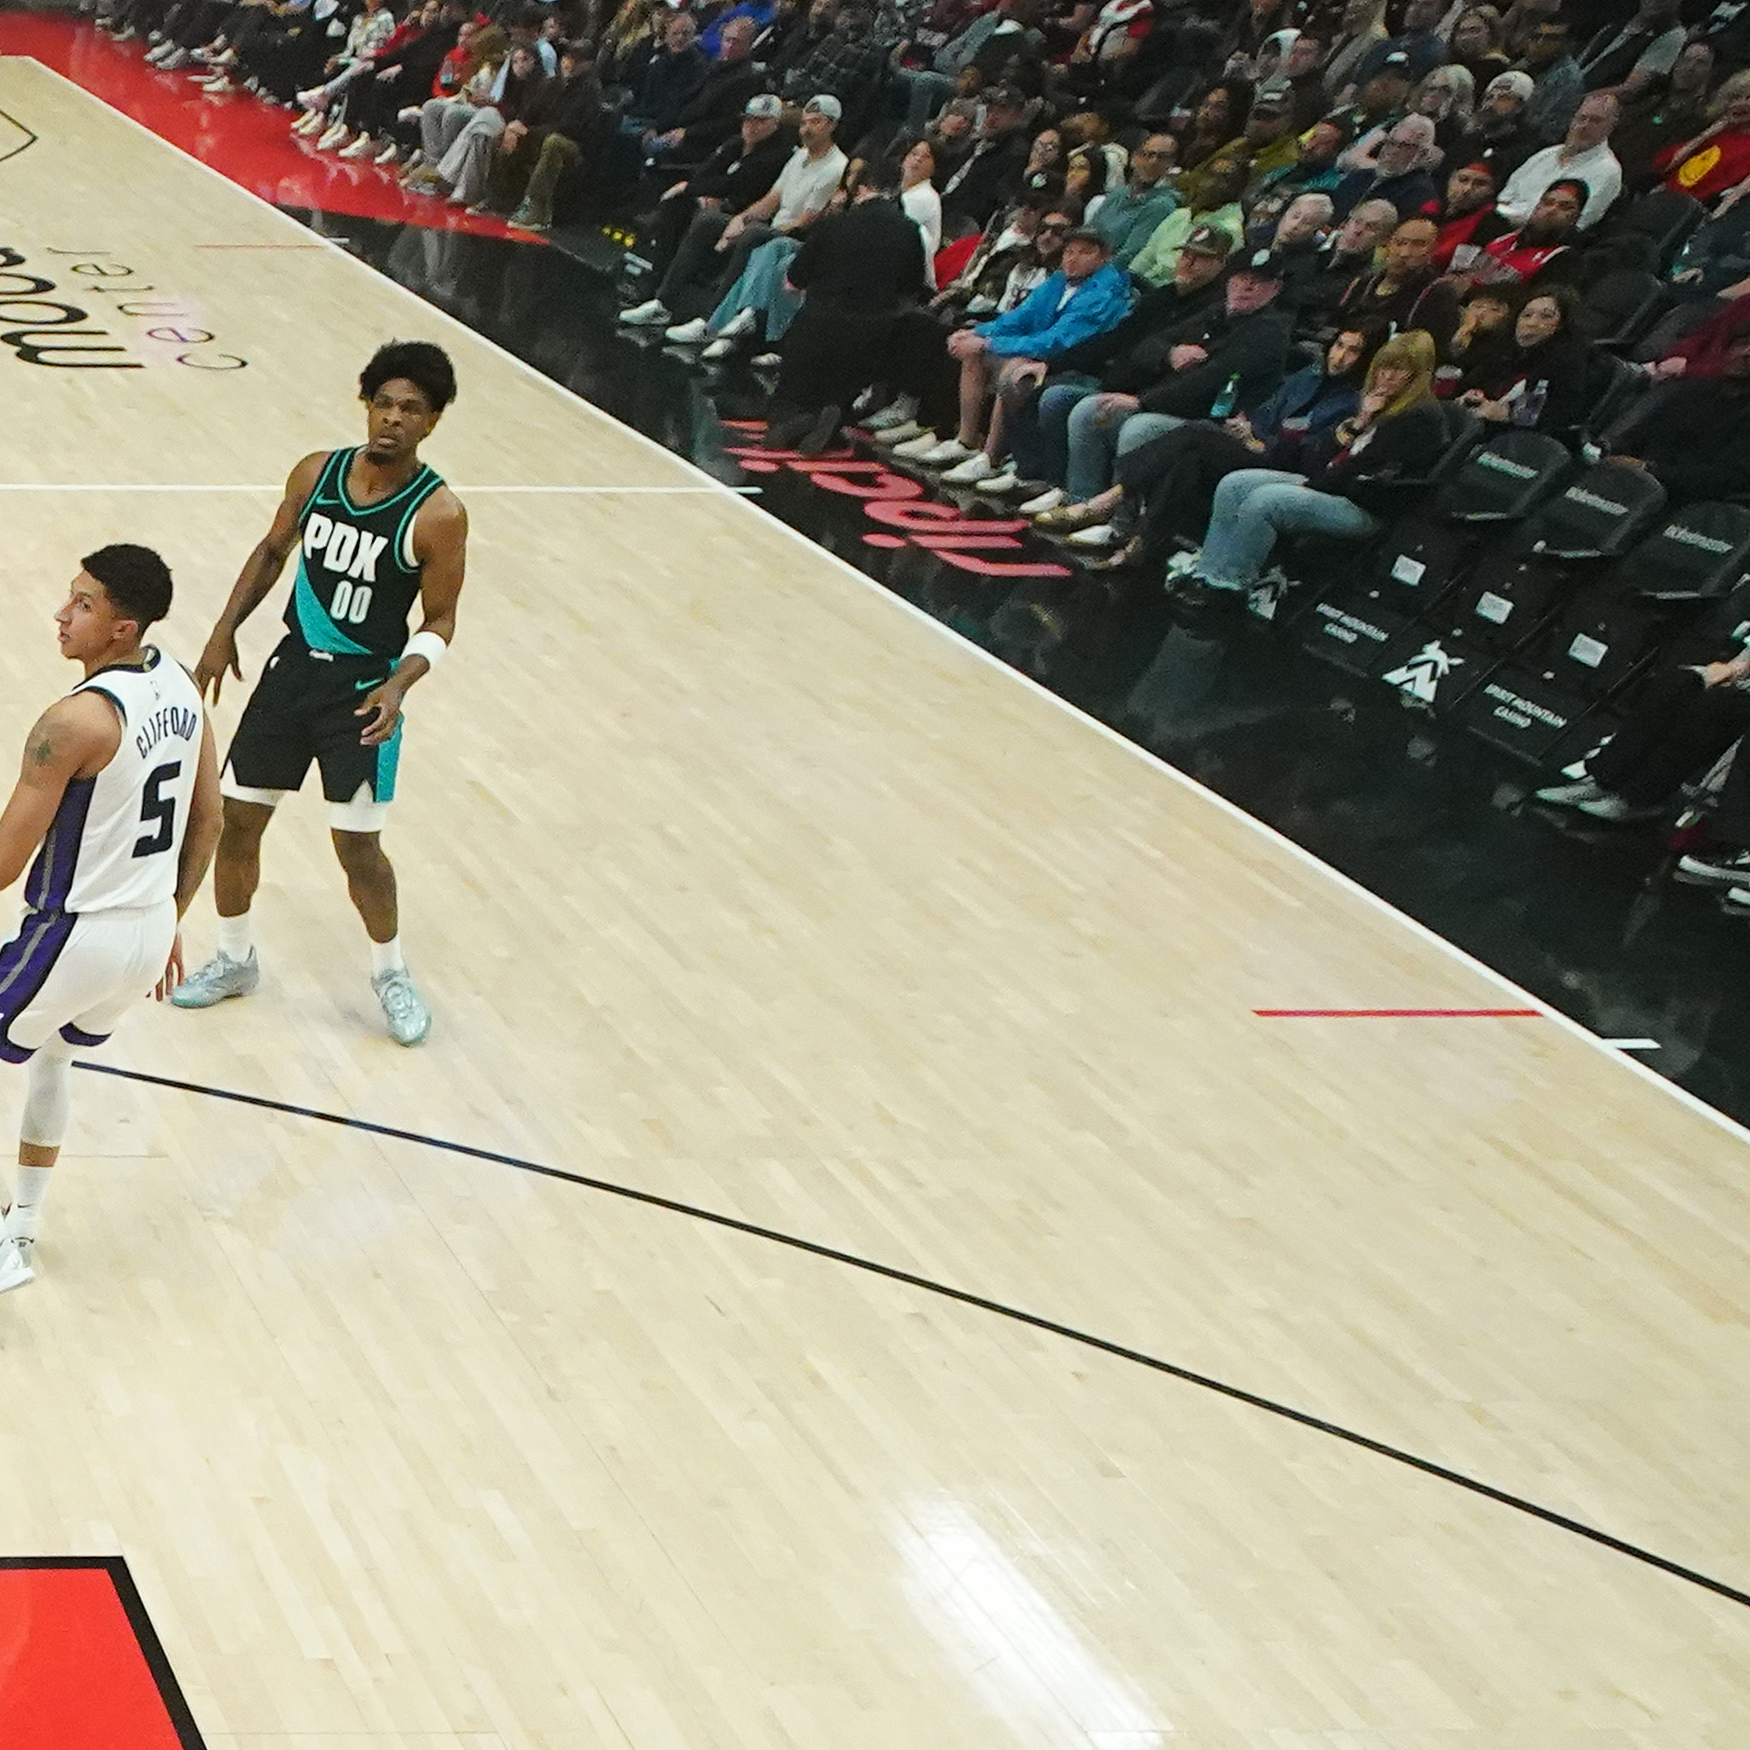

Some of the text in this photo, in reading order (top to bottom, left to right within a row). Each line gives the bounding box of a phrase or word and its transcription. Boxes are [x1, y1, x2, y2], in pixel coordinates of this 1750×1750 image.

[47, 246, 248, 370] center
[303, 512, 388, 584] PDX
[329, 580, 372, 624] 00
[136, 705, 197, 760] CLIFFORD
[131, 760, 183, 860] 5
